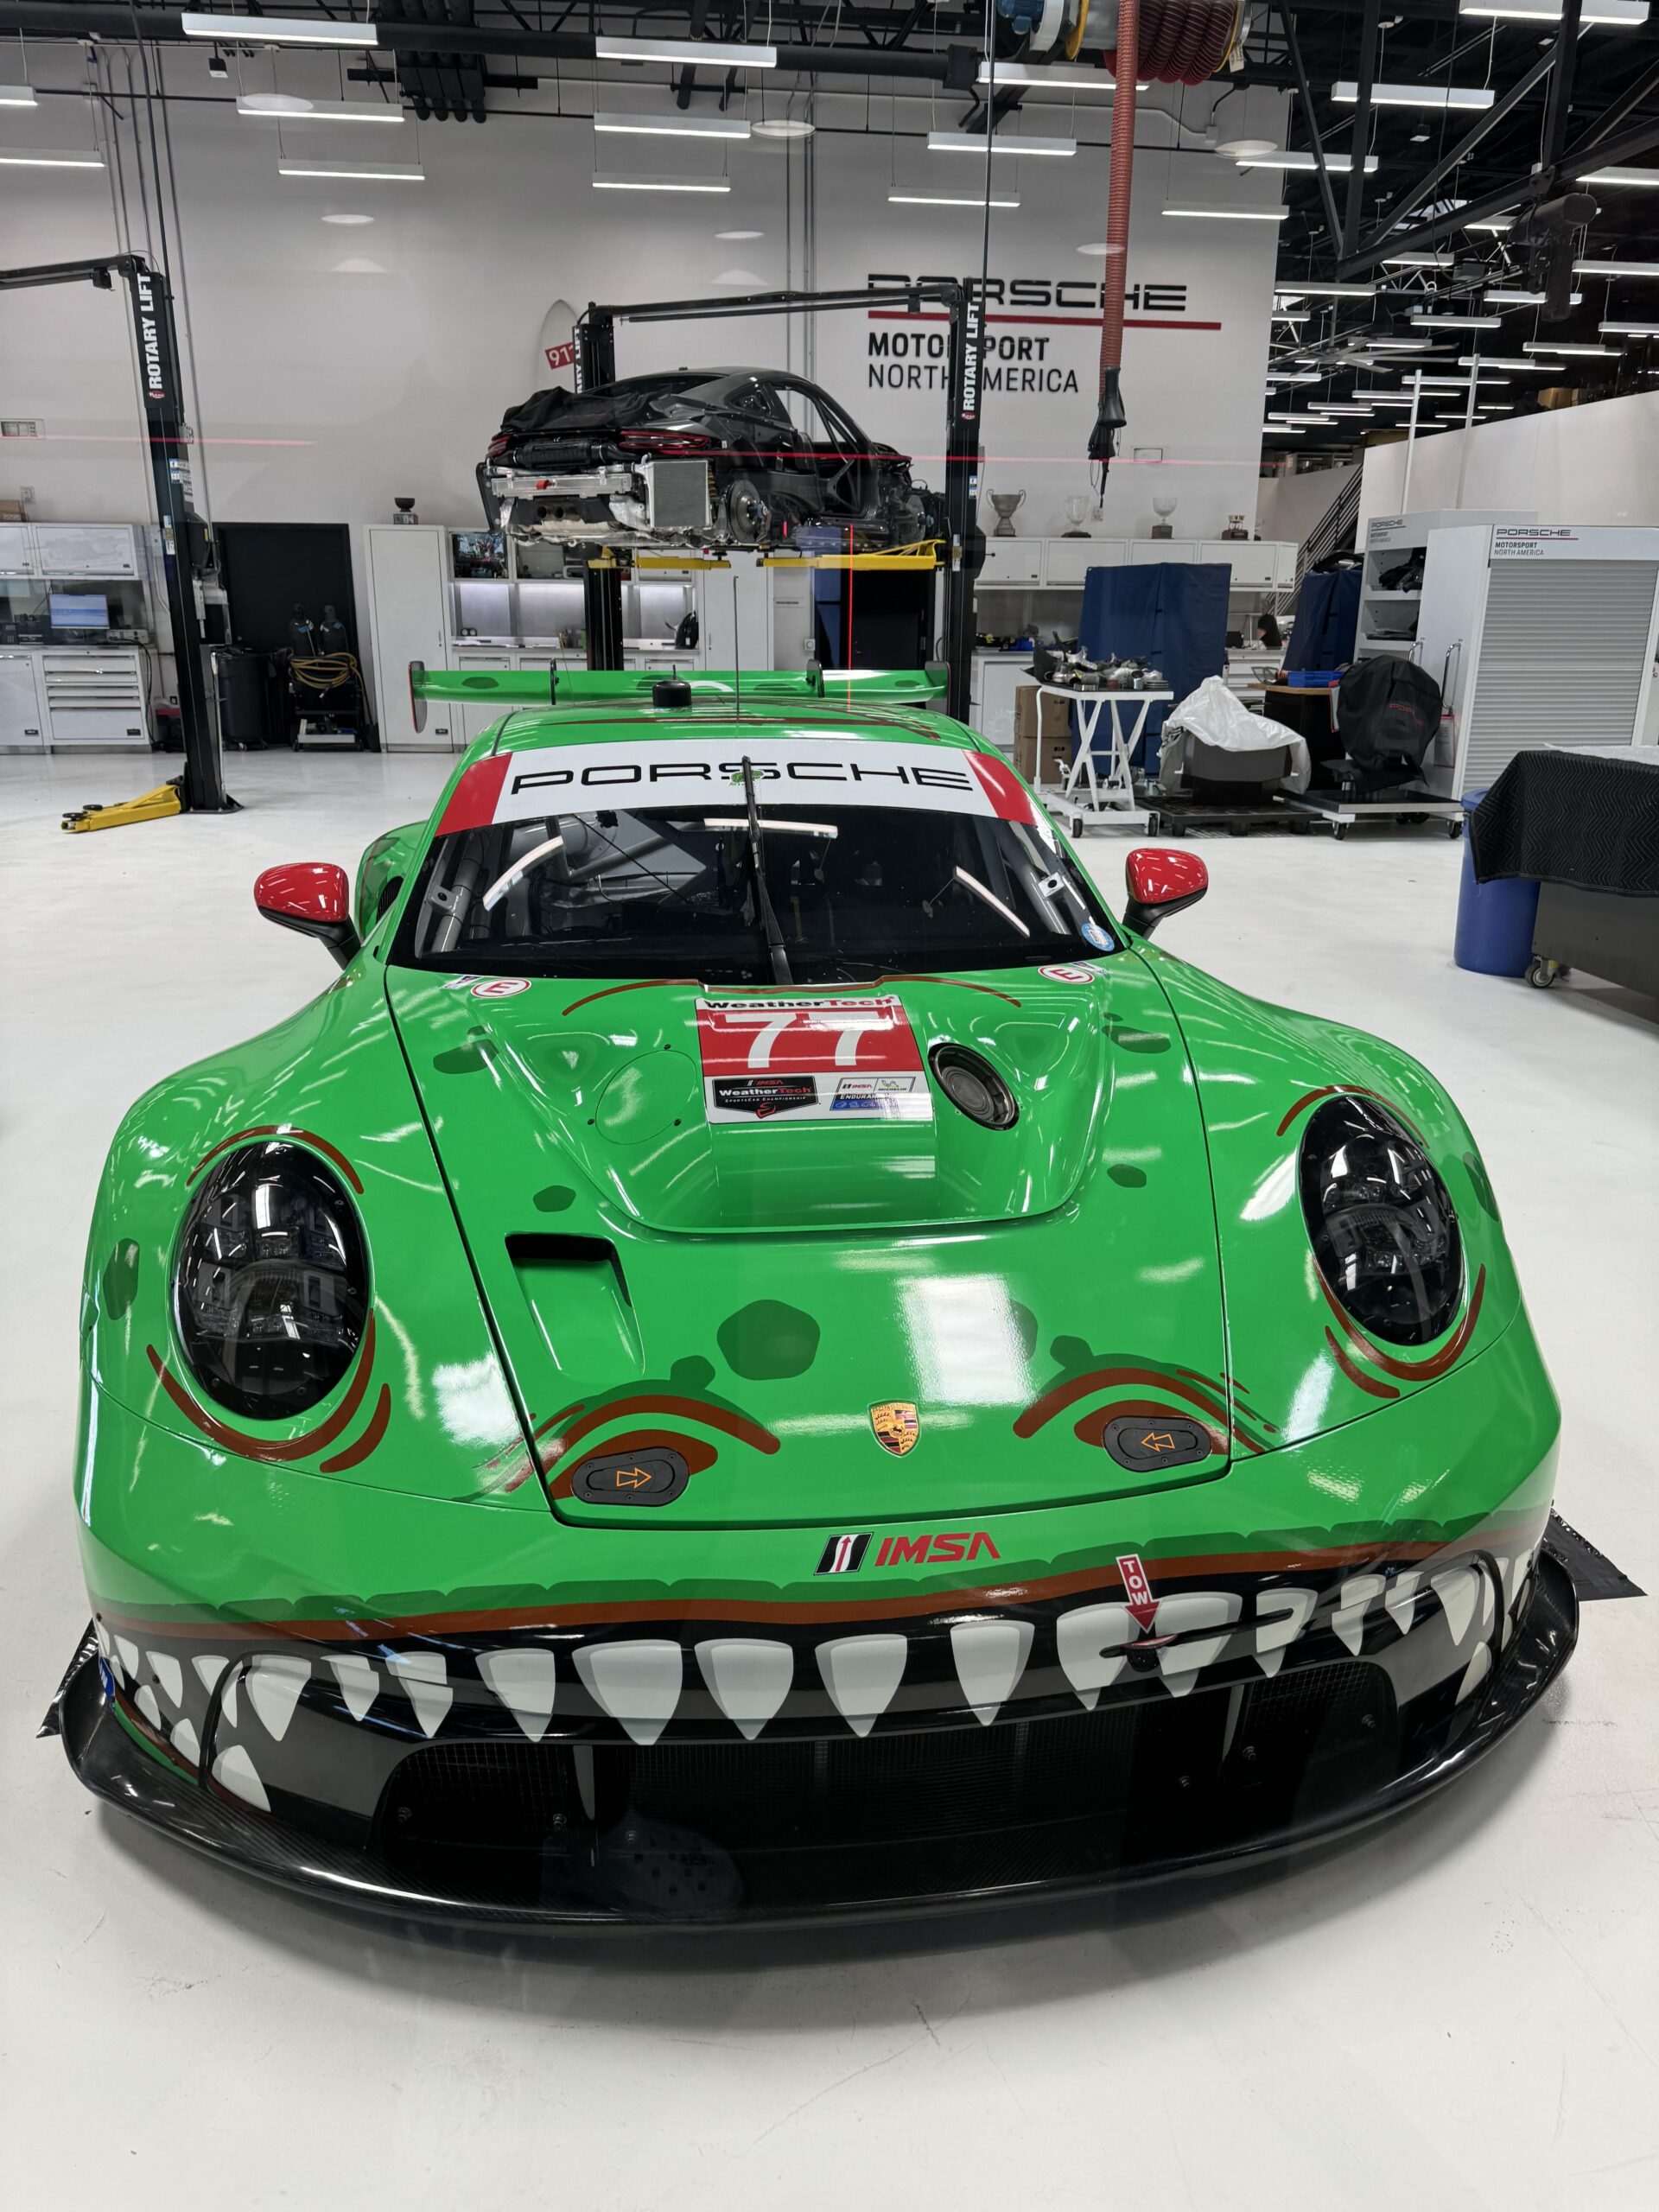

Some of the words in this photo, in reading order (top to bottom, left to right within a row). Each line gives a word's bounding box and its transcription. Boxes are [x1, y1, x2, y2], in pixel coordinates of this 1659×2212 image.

[137, 273, 154, 312] LIFT
[966, 302, 979, 339] LIFT
[142, 316, 162, 389] ROTARY
[549, 344, 574, 366] 91
[963, 343, 976, 410] ROTARY
[983, 367, 1078, 393] MERICA
[512, 762, 974, 795] PORSCHE
[482, 982, 519, 994] E
[1049, 969, 1084, 981] E
[704, 996, 893, 1009] WeatherTech
[724, 1010, 881, 1069] 77
[719, 1087, 812, 1096] WeatherTech
[874, 1532, 1001, 1567] IMSA
[1122, 1560, 1148, 1605] TOW
